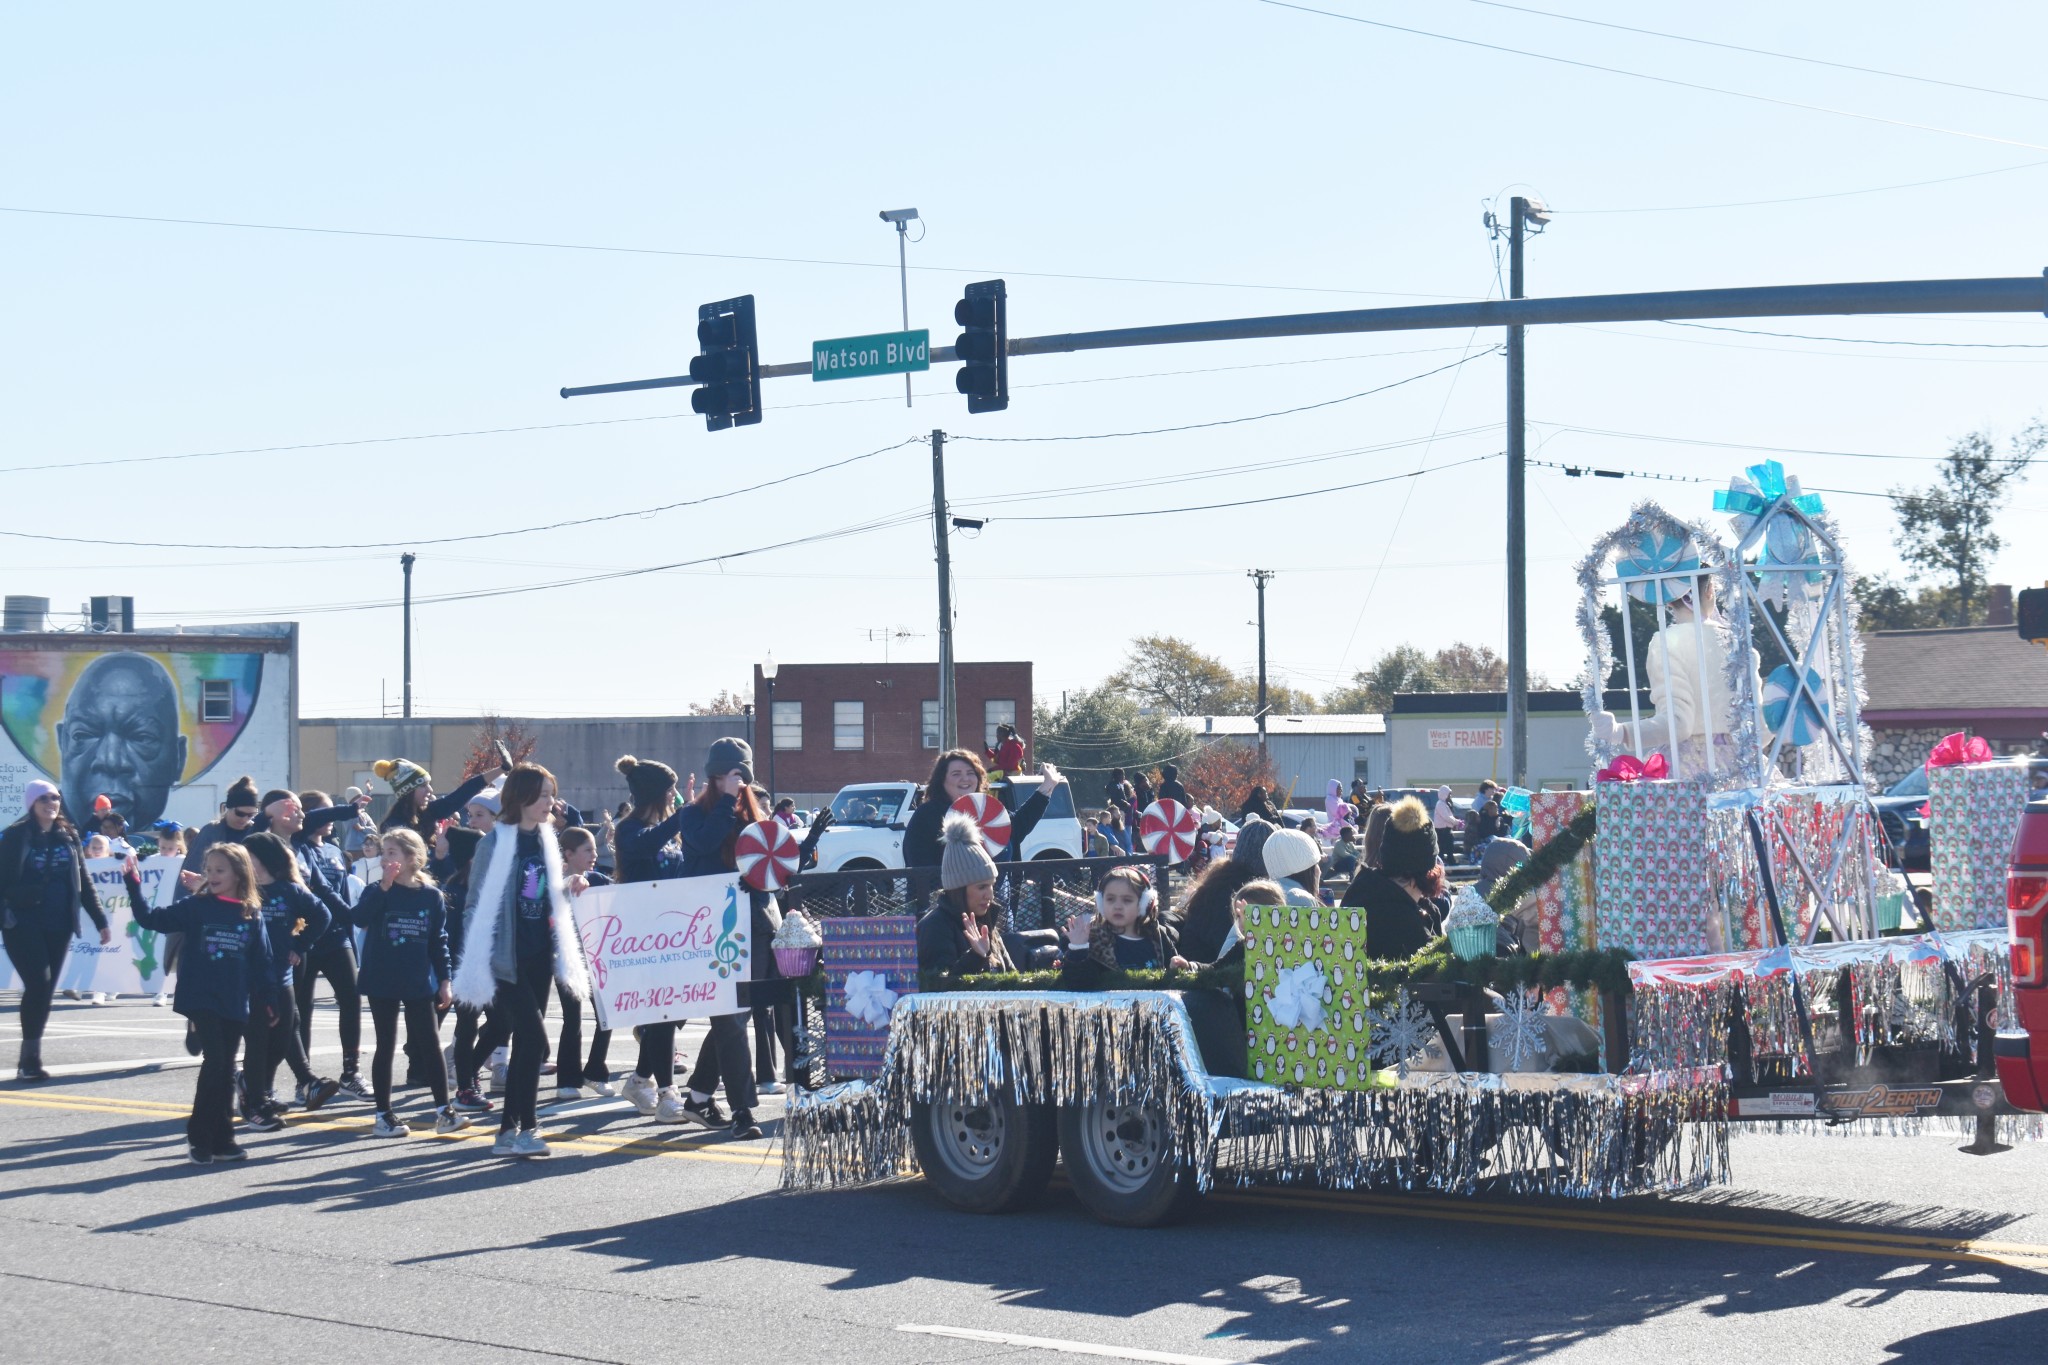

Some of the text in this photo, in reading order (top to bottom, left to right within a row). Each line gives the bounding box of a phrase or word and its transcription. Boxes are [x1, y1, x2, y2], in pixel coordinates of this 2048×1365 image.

[816, 341, 926, 371] Watson Blvd
[1430, 730, 1451, 739] West
[1432, 739, 1449, 748] End
[1454, 730, 1503, 748] FRAMES
[581, 905, 718, 965] Peacock's
[608, 949, 714, 970] PERFORMING ARTS CENTER
[614, 981, 717, 1012] 478-302-5642
